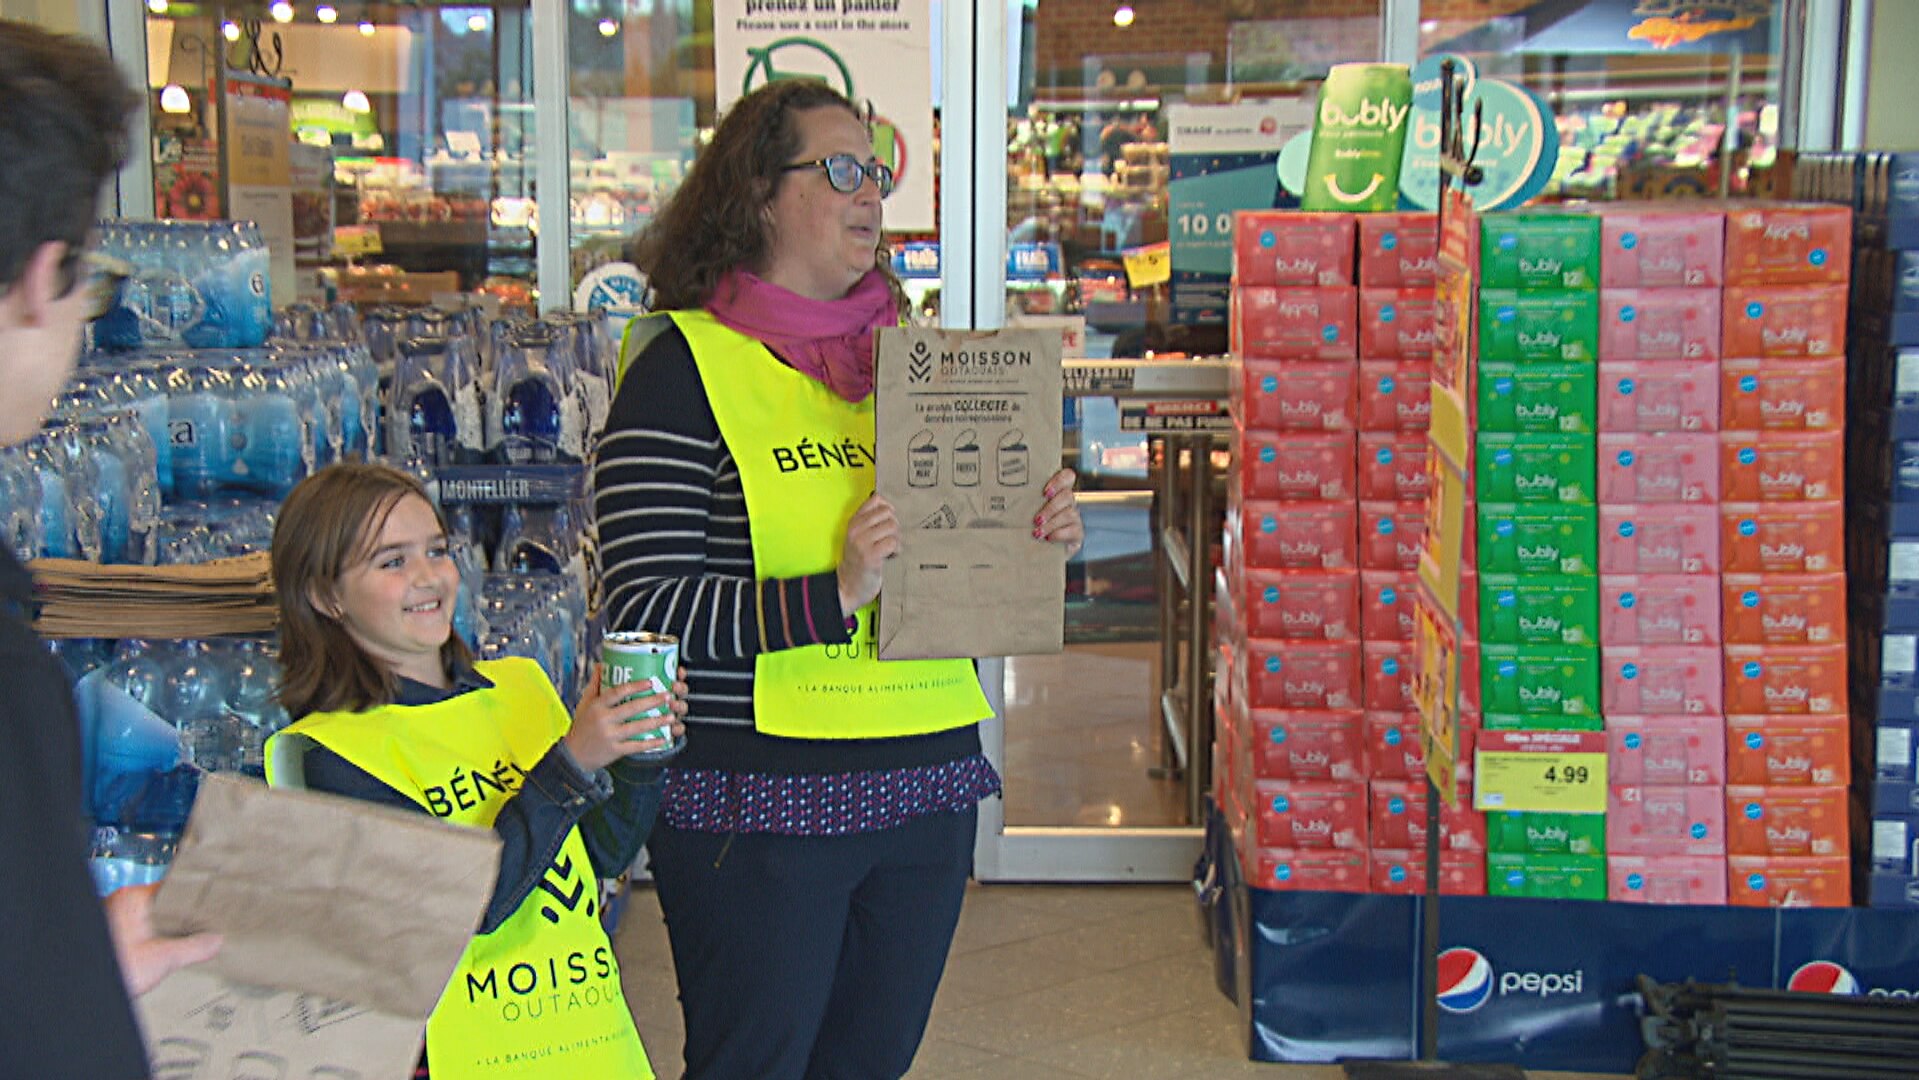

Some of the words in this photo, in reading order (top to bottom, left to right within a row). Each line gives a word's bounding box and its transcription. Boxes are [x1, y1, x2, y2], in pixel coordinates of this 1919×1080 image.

[1320, 97, 1410, 132] bubly
[1415, 112, 1528, 156] bbly
[1177, 214, 1209, 234] 10
[1519, 258, 1562, 275] bubly
[1518, 332, 1561, 348] bubly
[940, 351, 1031, 366] MOISSON
[954, 400, 1009, 412] COLLECTE
[1516, 404, 1558, 419] bubly
[169, 421, 194, 444] a
[1515, 474, 1557, 489] bubly
[1517, 545, 1559, 561] bubly
[1519, 616, 1561, 632] bubly
[1519, 686, 1561, 701] bubly
[1544, 766, 1589, 783] 4.99
[1527, 827, 1568, 842] bubly
[466, 947, 613, 1003] MOISS
[1500, 968, 1583, 994] pepsi
[502, 986, 620, 1021] OUTAOU
